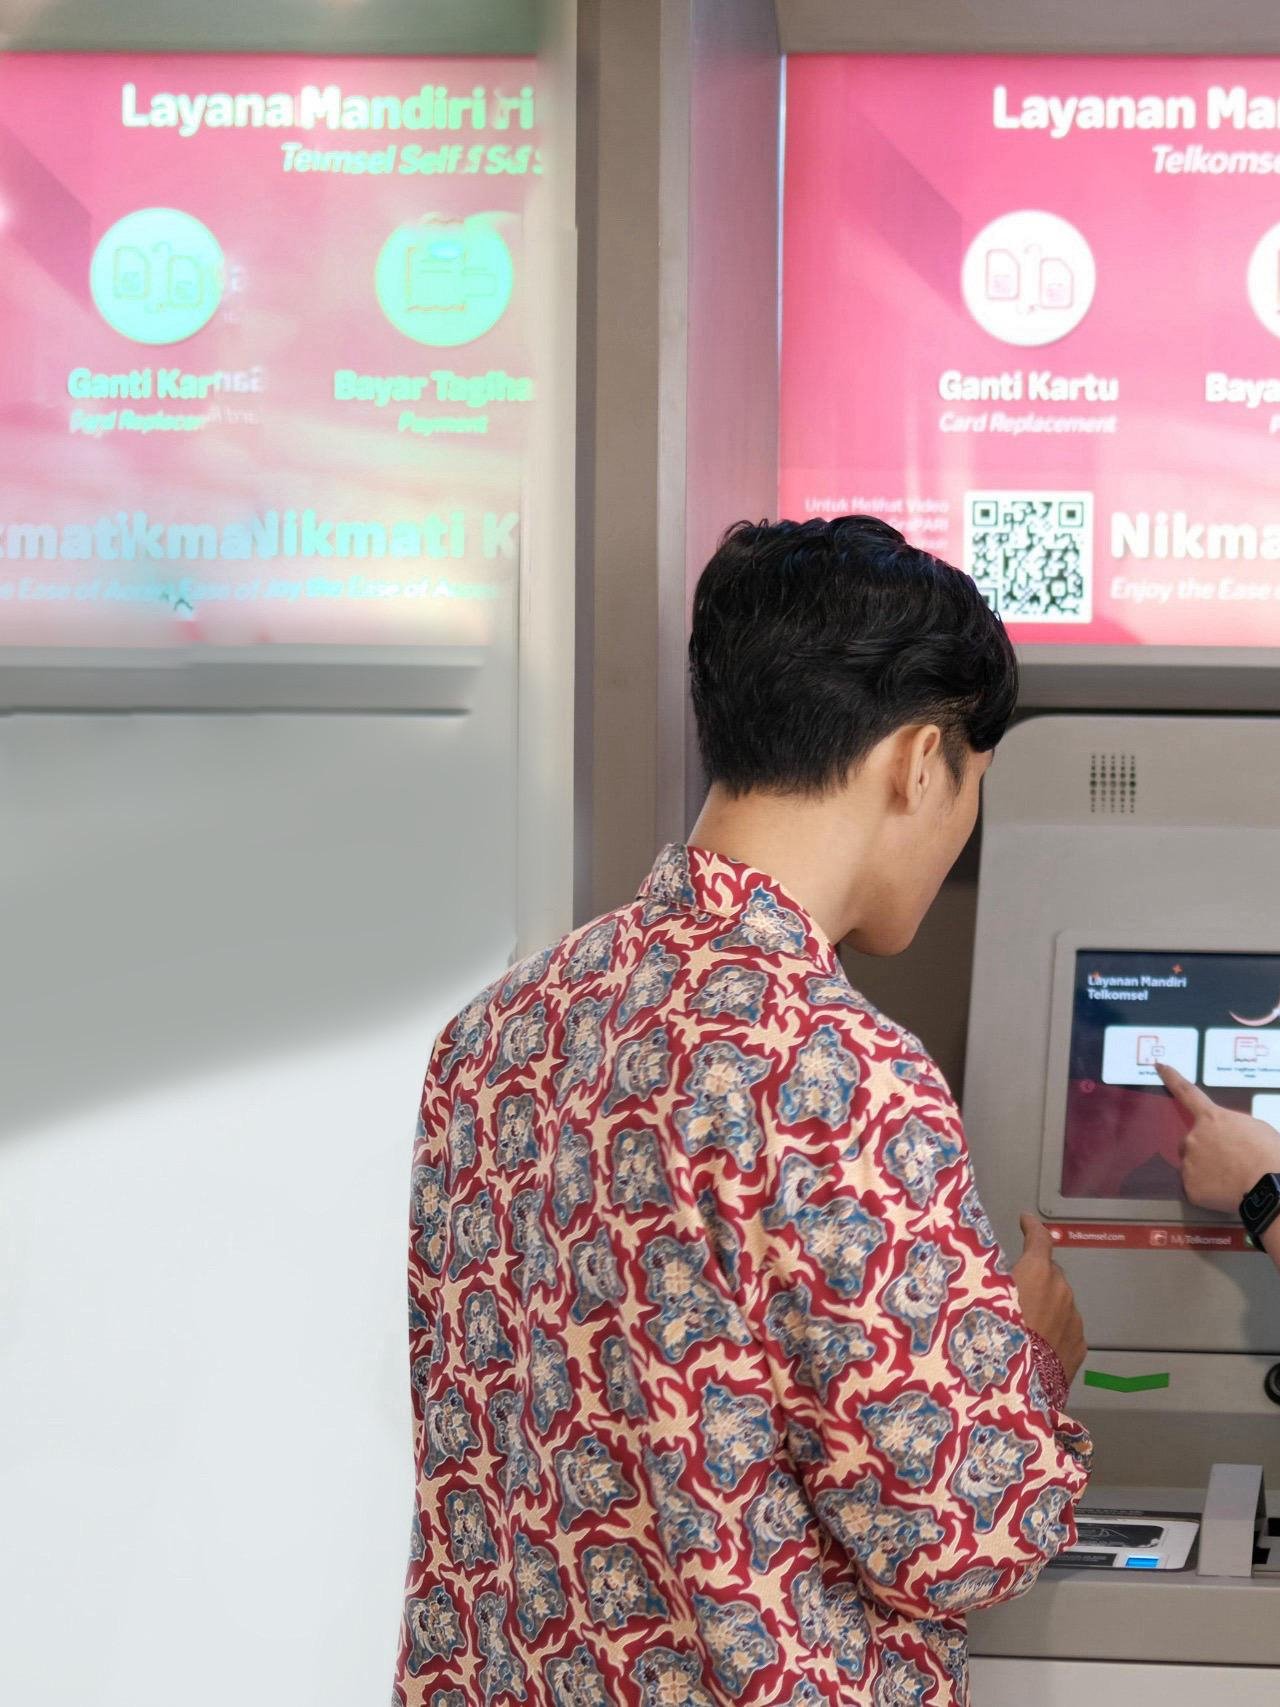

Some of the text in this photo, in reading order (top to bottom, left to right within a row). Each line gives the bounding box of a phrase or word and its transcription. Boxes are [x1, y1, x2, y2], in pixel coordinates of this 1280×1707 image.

[993, 86, 1196, 137] Layanan
[939, 371, 1118, 402] Ganti Kartu
[939, 411, 1117, 434] Card Replacement
[1110, 577, 1171, 604] Enjoy
[1177, 577, 1213, 600] the
[1216, 577, 1272, 601] Ease
[1088, 975, 1187, 988] Layanan Mandiri
[1088, 988, 1148, 1001] Telkomsel
